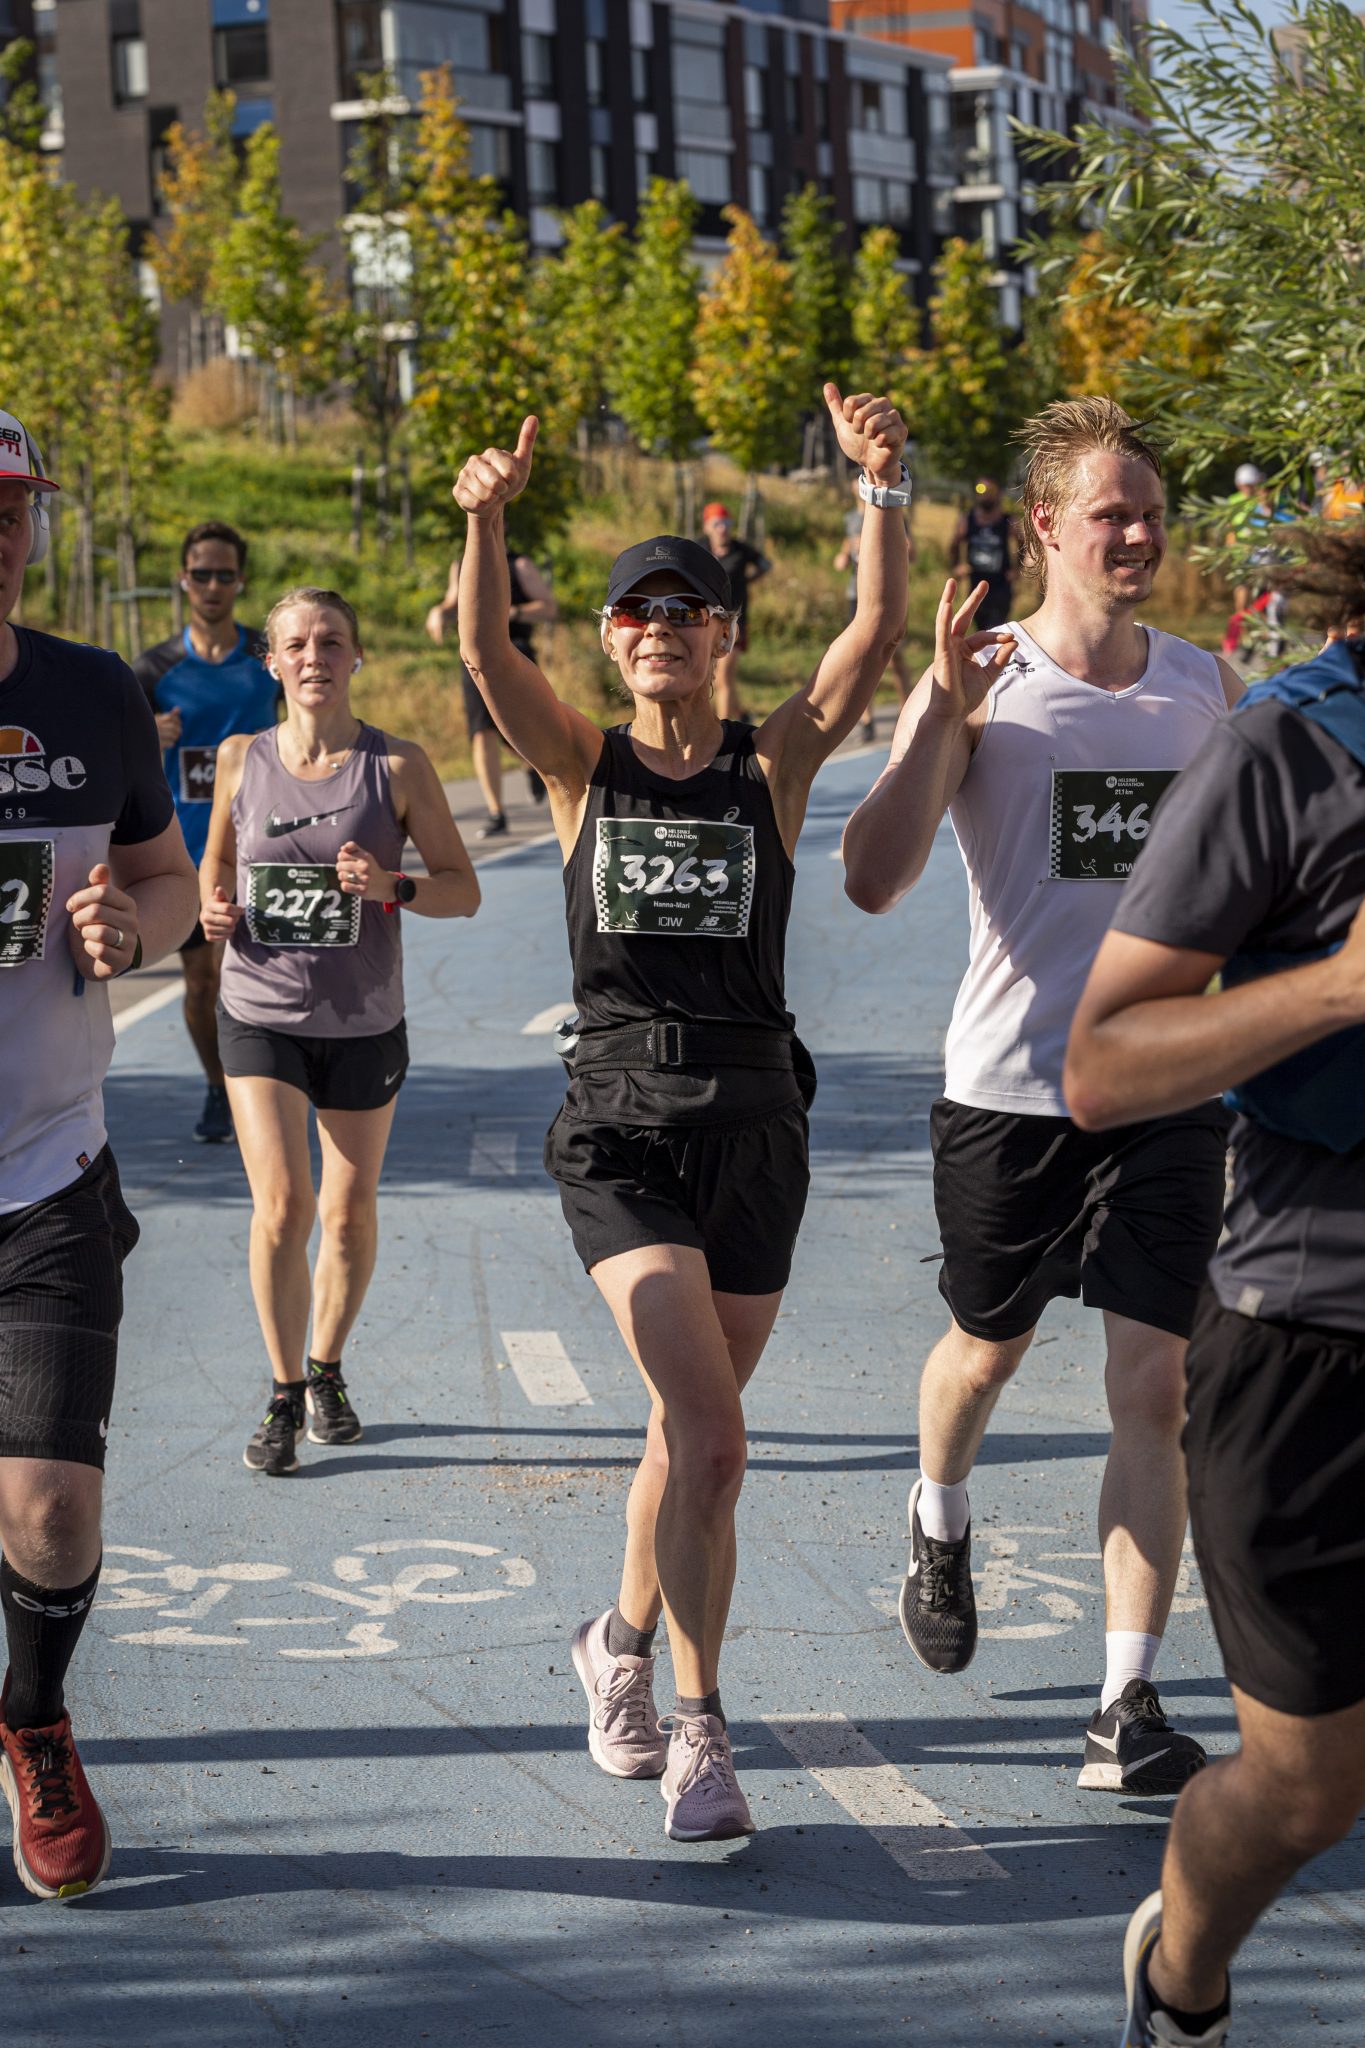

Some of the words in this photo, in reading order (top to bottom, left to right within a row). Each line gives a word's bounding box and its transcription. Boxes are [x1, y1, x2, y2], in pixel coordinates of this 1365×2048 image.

[0, 427, 22, 442] ED
[273, 816, 338, 826] NIKE
[1072, 802, 1151, 843] 346
[617, 854, 729, 898] 3263
[264, 888, 342, 921] 2272
[653, 900, 691, 909] Hanna-Mari
